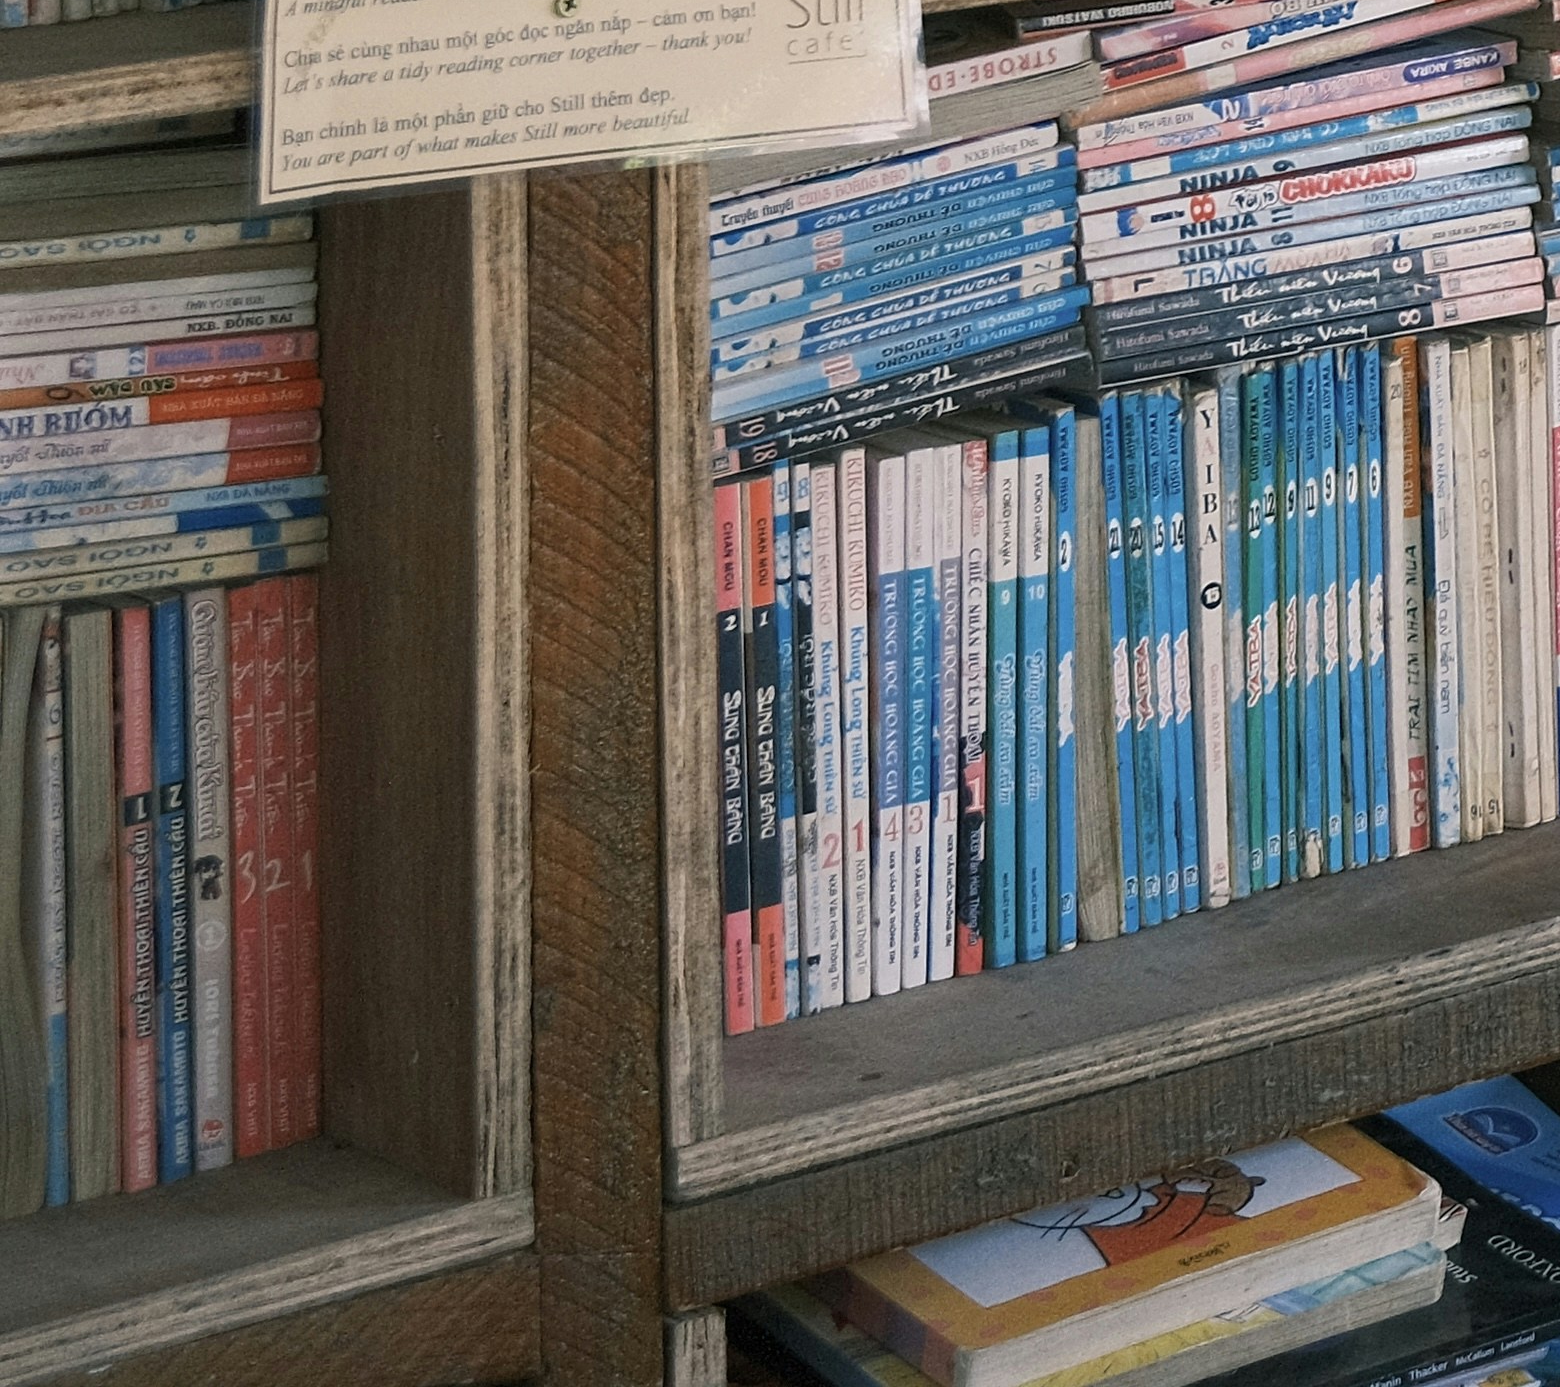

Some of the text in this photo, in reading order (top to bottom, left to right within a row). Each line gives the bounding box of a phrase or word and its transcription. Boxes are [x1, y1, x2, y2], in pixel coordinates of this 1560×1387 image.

[284, 1, 757, 69] Chia sẻ cùng nhau một góc đọc ngăn nắp cảm ơn bạn!
[285, 1, 297, 17] A
[282, 27, 752, 96] Let's share a tidy reading corner together thank you!
[282, 85, 675, 148] Bạn chính là một phần giữ cho Still thêm đẹp.
[282, 152, 311, 173] You
[317, 149, 346, 165] are
[350, 143, 389, 168] part
[394, 138, 415, 160] of
[417, 136, 459, 156] what
[465, 130, 517, 150] makes
[522, 122, 560, 143] Still
[563, 116, 607, 138] more
[1179, 165, 1259, 193] NINJA
